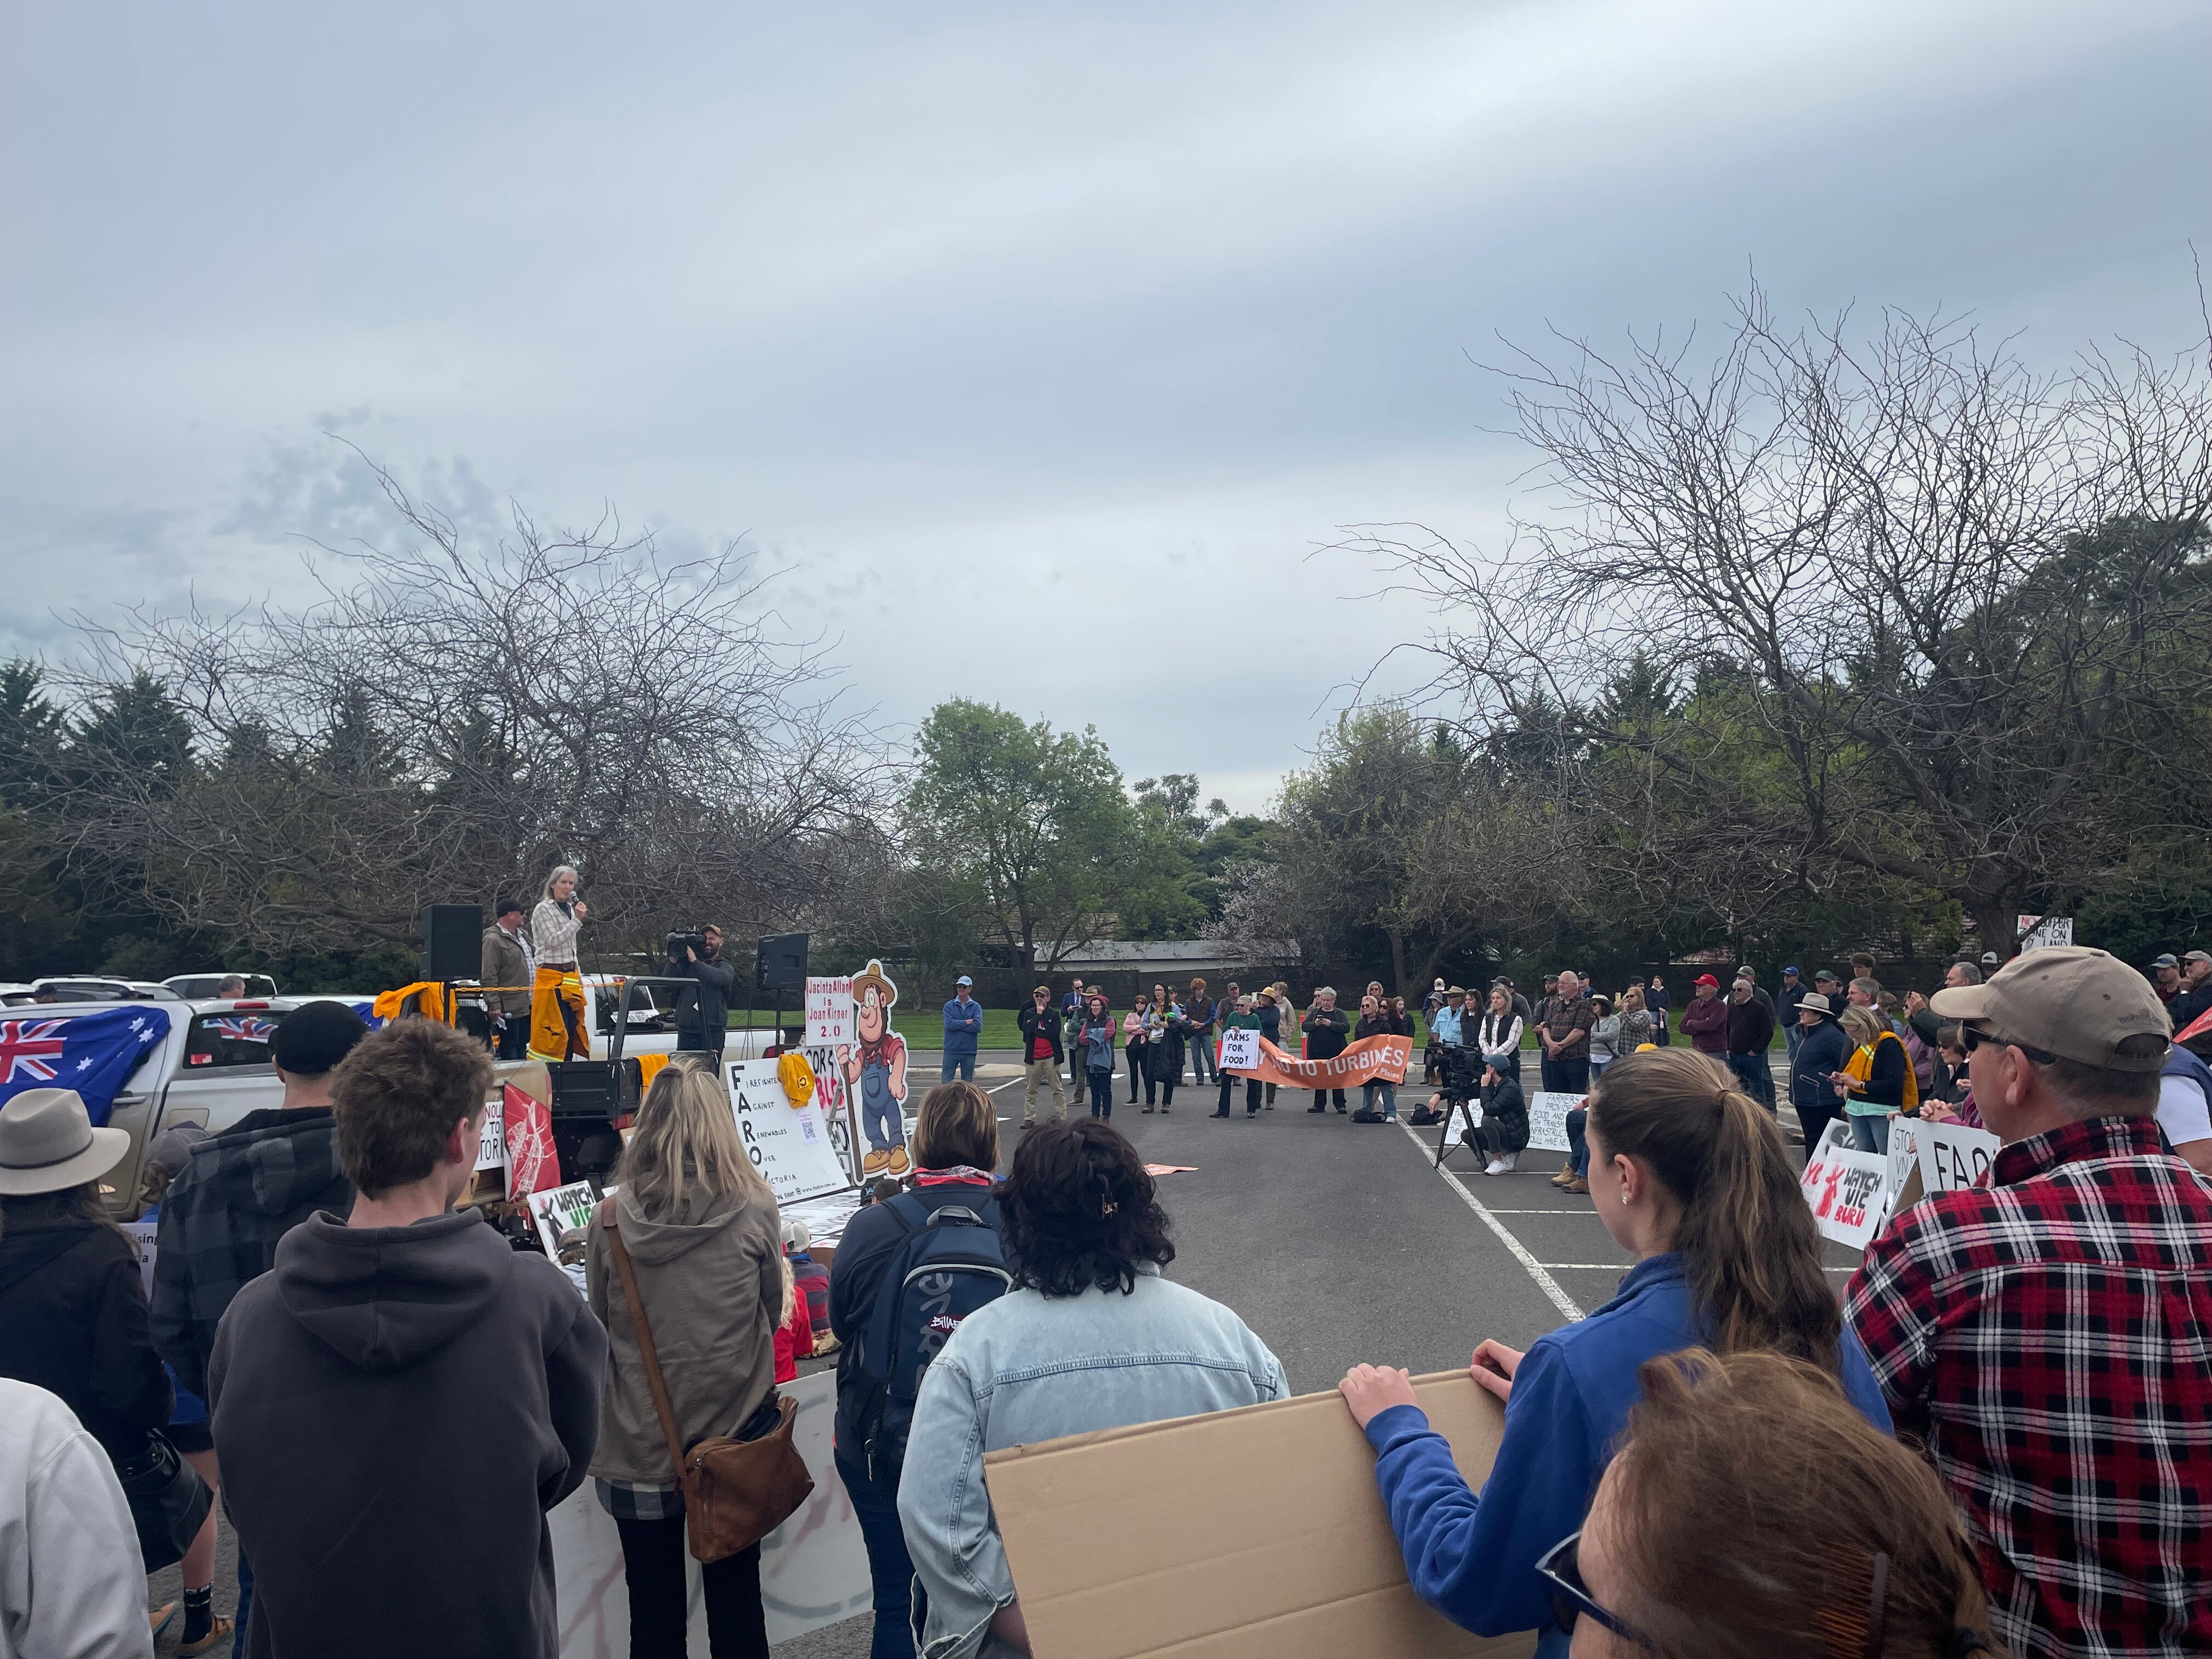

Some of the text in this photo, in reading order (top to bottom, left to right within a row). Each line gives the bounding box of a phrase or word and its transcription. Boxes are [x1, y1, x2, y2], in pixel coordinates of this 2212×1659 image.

[2022, 916, 2036, 926] NO
[2052, 929, 2067, 939] ON
[809, 980, 849, 994] Jacinta Allan
[809, 1007, 848, 1020] Joan Kirner
[821, 1025, 840, 1037] 2.0
[1225, 1033, 1250, 1041] FARMS
[1228, 1043, 1244, 1052] FOR
[1224, 1056, 1249, 1064] FOOD!
[1296, 1060, 1317, 1076] TO
[1322, 1046, 1404, 1076] TURBINES
[1379, 1067, 1400, 1079] Plains
[738, 1092, 775, 1114] AGAINST
[1547, 1093, 1579, 1104] FARMERS
[1533, 1110, 1549, 1119] FOOD
[489, 1121, 500, 1134] TO
[742, 1120, 788, 1143] RENEWABLES
[1894, 1128, 1914, 1153] STO
[749, 1146, 776, 1166] OVER
[1843, 1167, 1883, 1193] WATCH
[554, 1186, 595, 1212] WATCH
[1844, 1188, 1870, 1209] VIC
[1834, 1205, 1866, 1228] BURN
